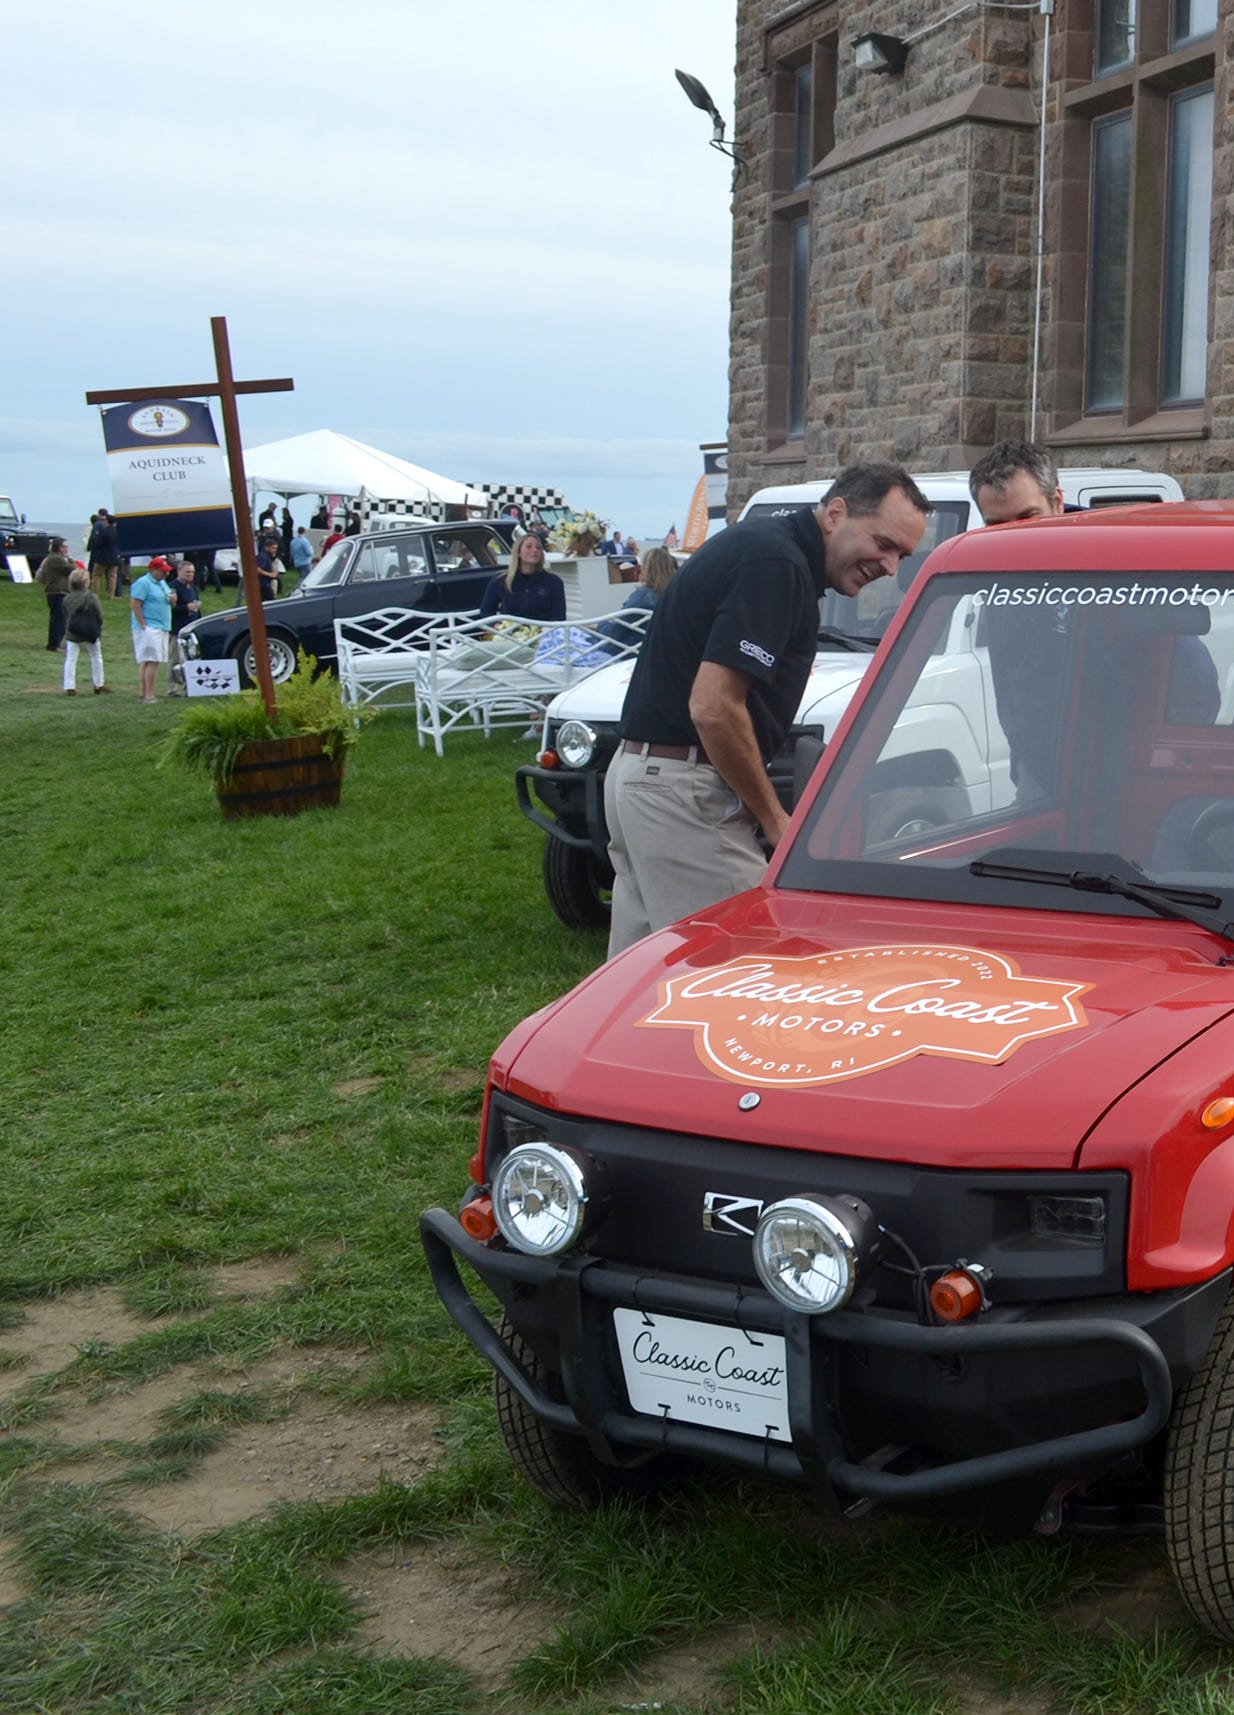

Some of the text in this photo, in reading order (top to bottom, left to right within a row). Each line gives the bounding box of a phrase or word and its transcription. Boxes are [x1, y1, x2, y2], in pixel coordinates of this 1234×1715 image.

[129, 456, 206, 470] AQUIDNECK
[152, 471, 186, 482] CLUB
[817, 950, 993, 980] ESTABLISHED 2022
[681, 963, 1059, 1025] Classic Coast
[751, 1012, 886, 1038] MOTORS
[724, 1037, 855, 1074] NEWPORT, RI
[633, 1331, 784, 1386] Classic Coast
[687, 1394, 741, 1413] MOTORS
